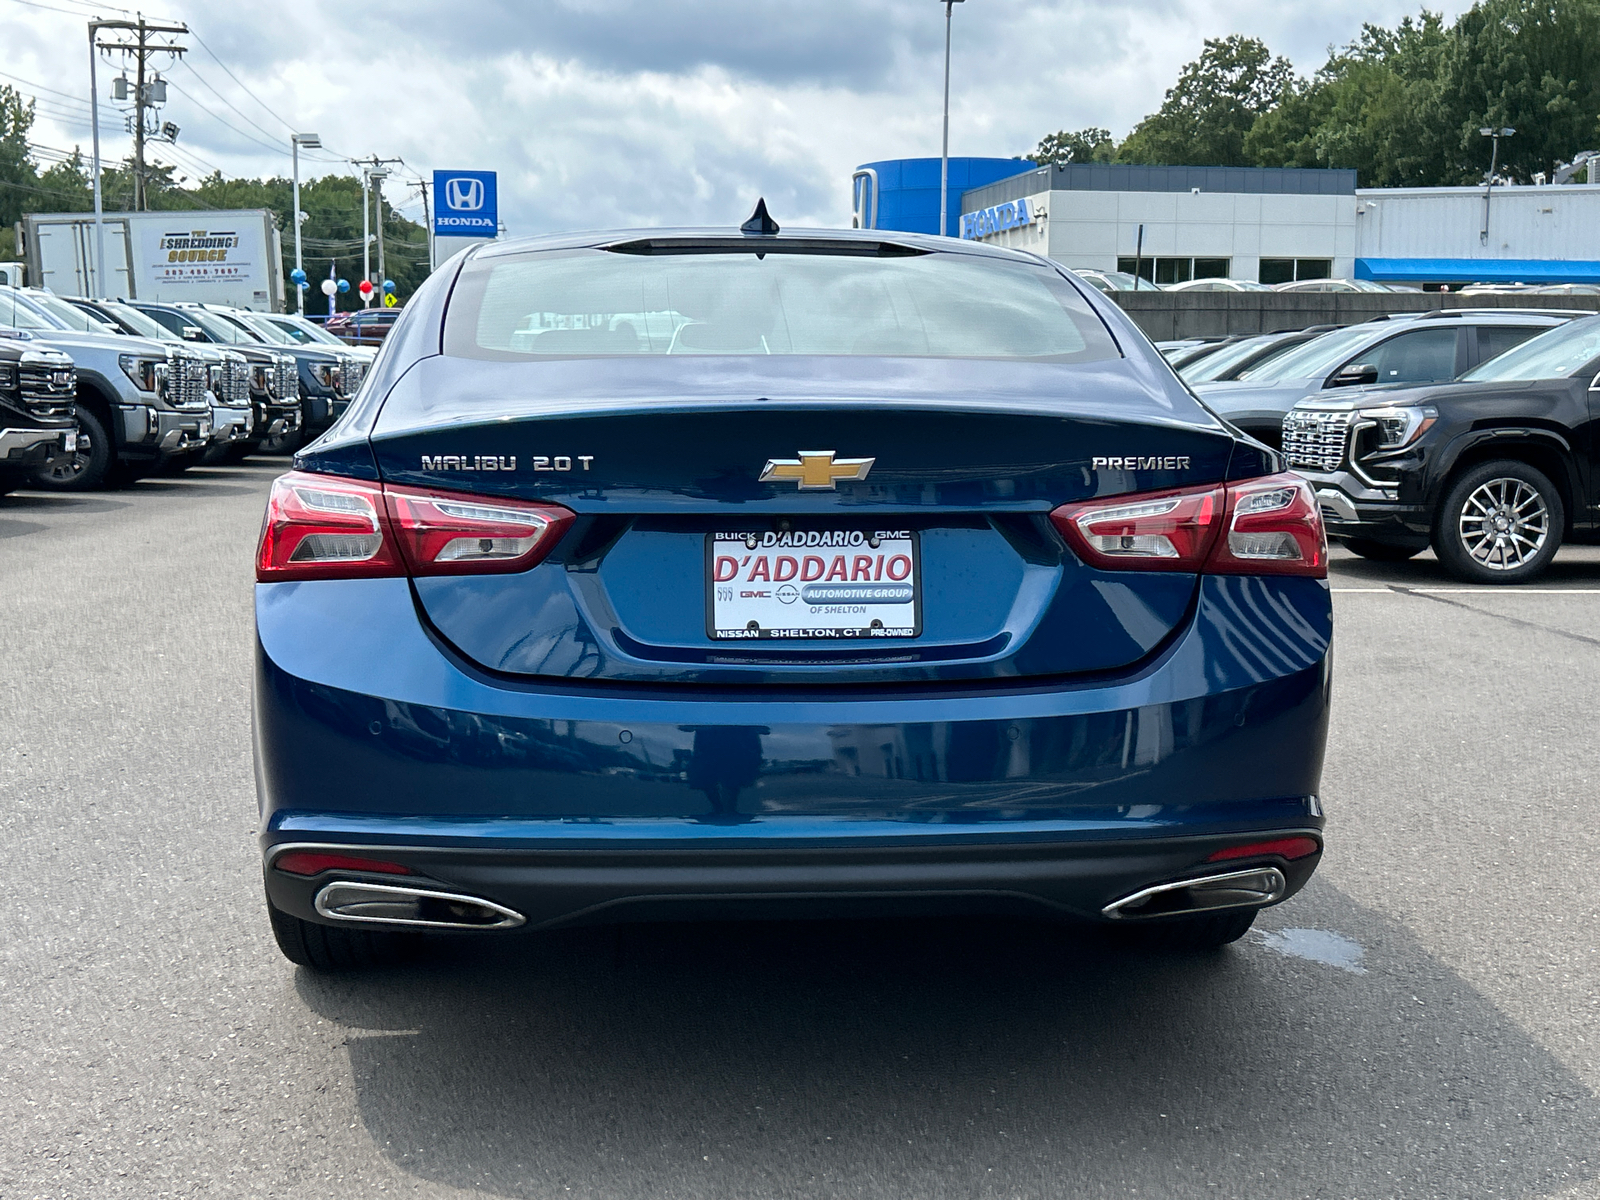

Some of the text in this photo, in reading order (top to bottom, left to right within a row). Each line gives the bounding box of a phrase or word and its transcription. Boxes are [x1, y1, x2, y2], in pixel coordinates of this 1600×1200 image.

[437, 217, 494, 226] HONDA
[963, 199, 1030, 240] HONDA
[166, 237, 233, 249] SHREDDING
[168, 250, 227, 262] SOURCE
[421, 455, 516, 471] MALIBU
[577, 455, 594, 471] T
[1092, 456, 1190, 470] PREMIER
[715, 530, 910, 547] BUICK D'ADDARIO GMC
[714, 554, 912, 582] D'ADDARIO
[808, 589, 909, 598] AUTOMOTIVE GROUP
[810, 606, 867, 614] OF SHELTON
[716, 630, 759, 638] NISSAN
[770, 629, 840, 638] SHELTON,
[870, 628, 913, 636] PRE-OWNED
